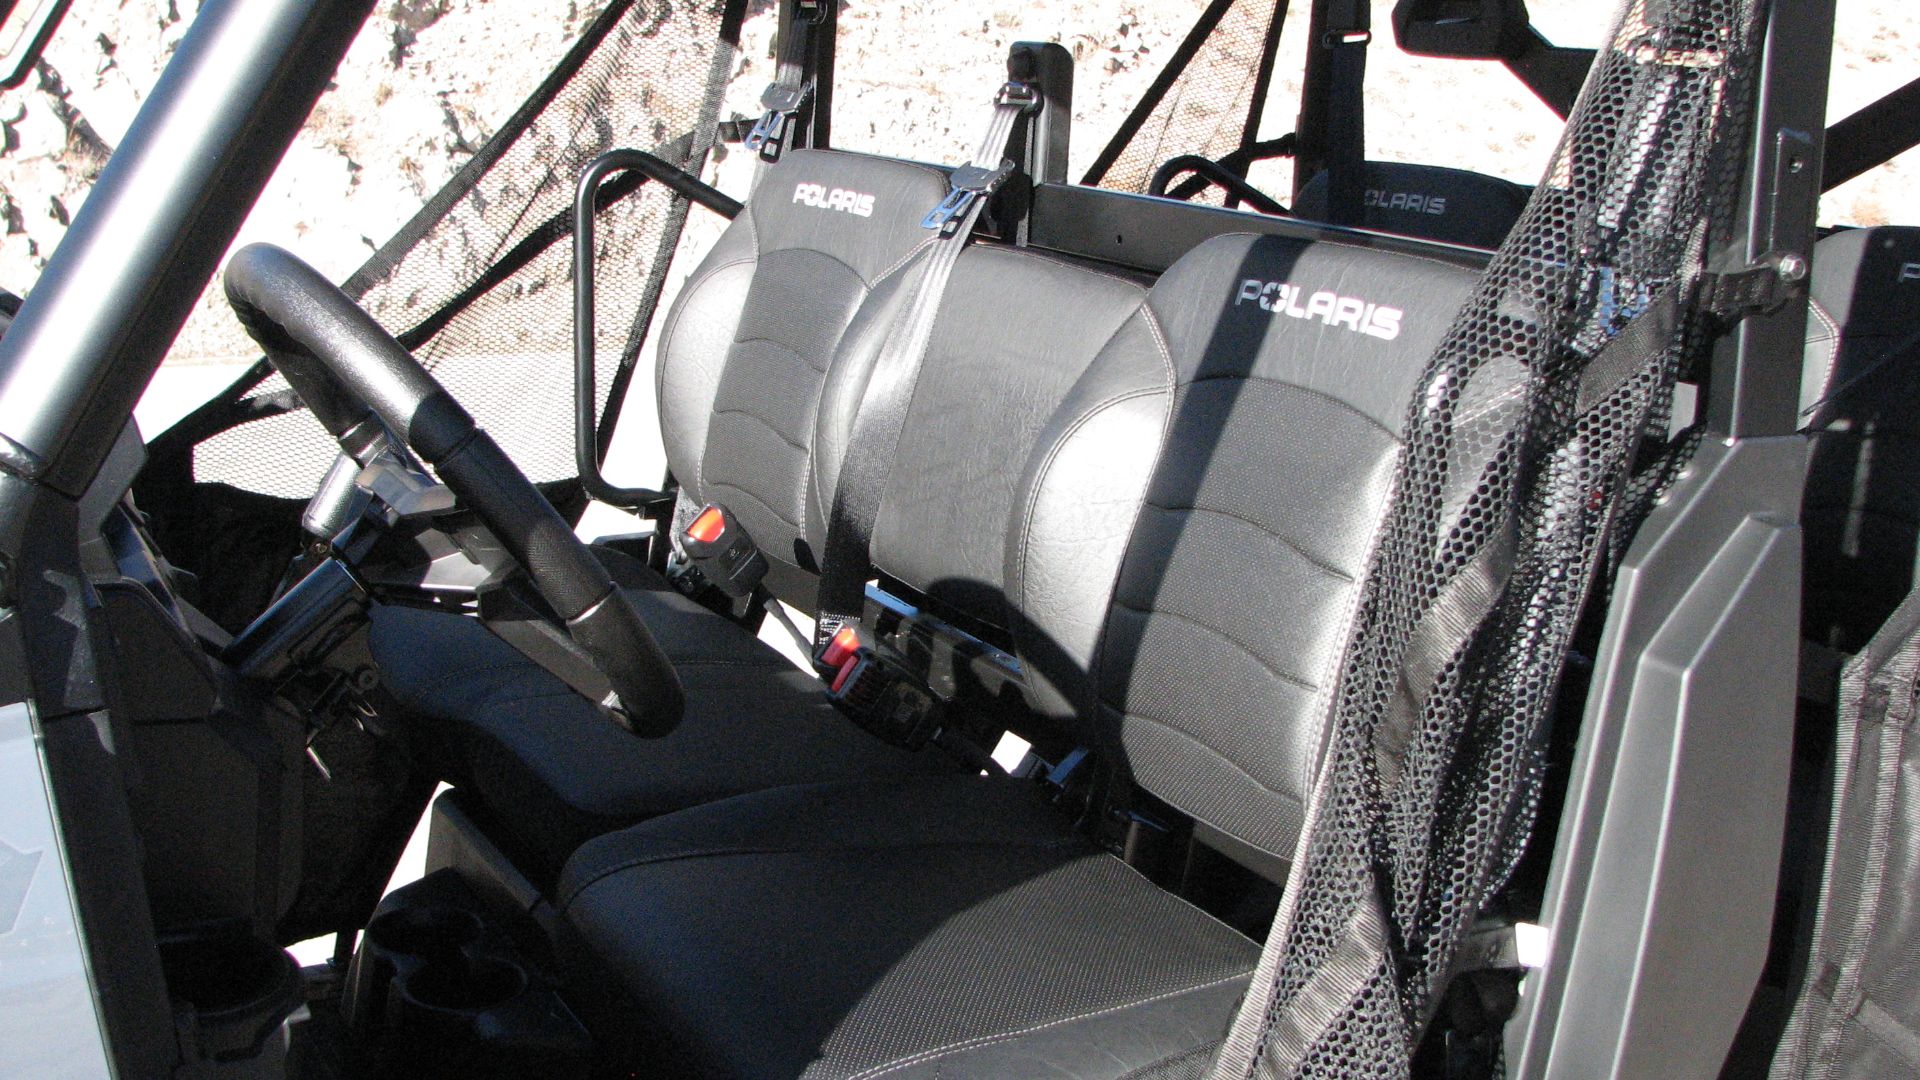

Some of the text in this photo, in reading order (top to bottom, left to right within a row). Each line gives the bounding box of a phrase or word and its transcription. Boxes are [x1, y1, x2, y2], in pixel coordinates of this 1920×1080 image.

[792, 183, 876, 218] POLARIS
[1363, 189, 1446, 215] OLARIS
[1235, 279, 1403, 341] POLARIS
